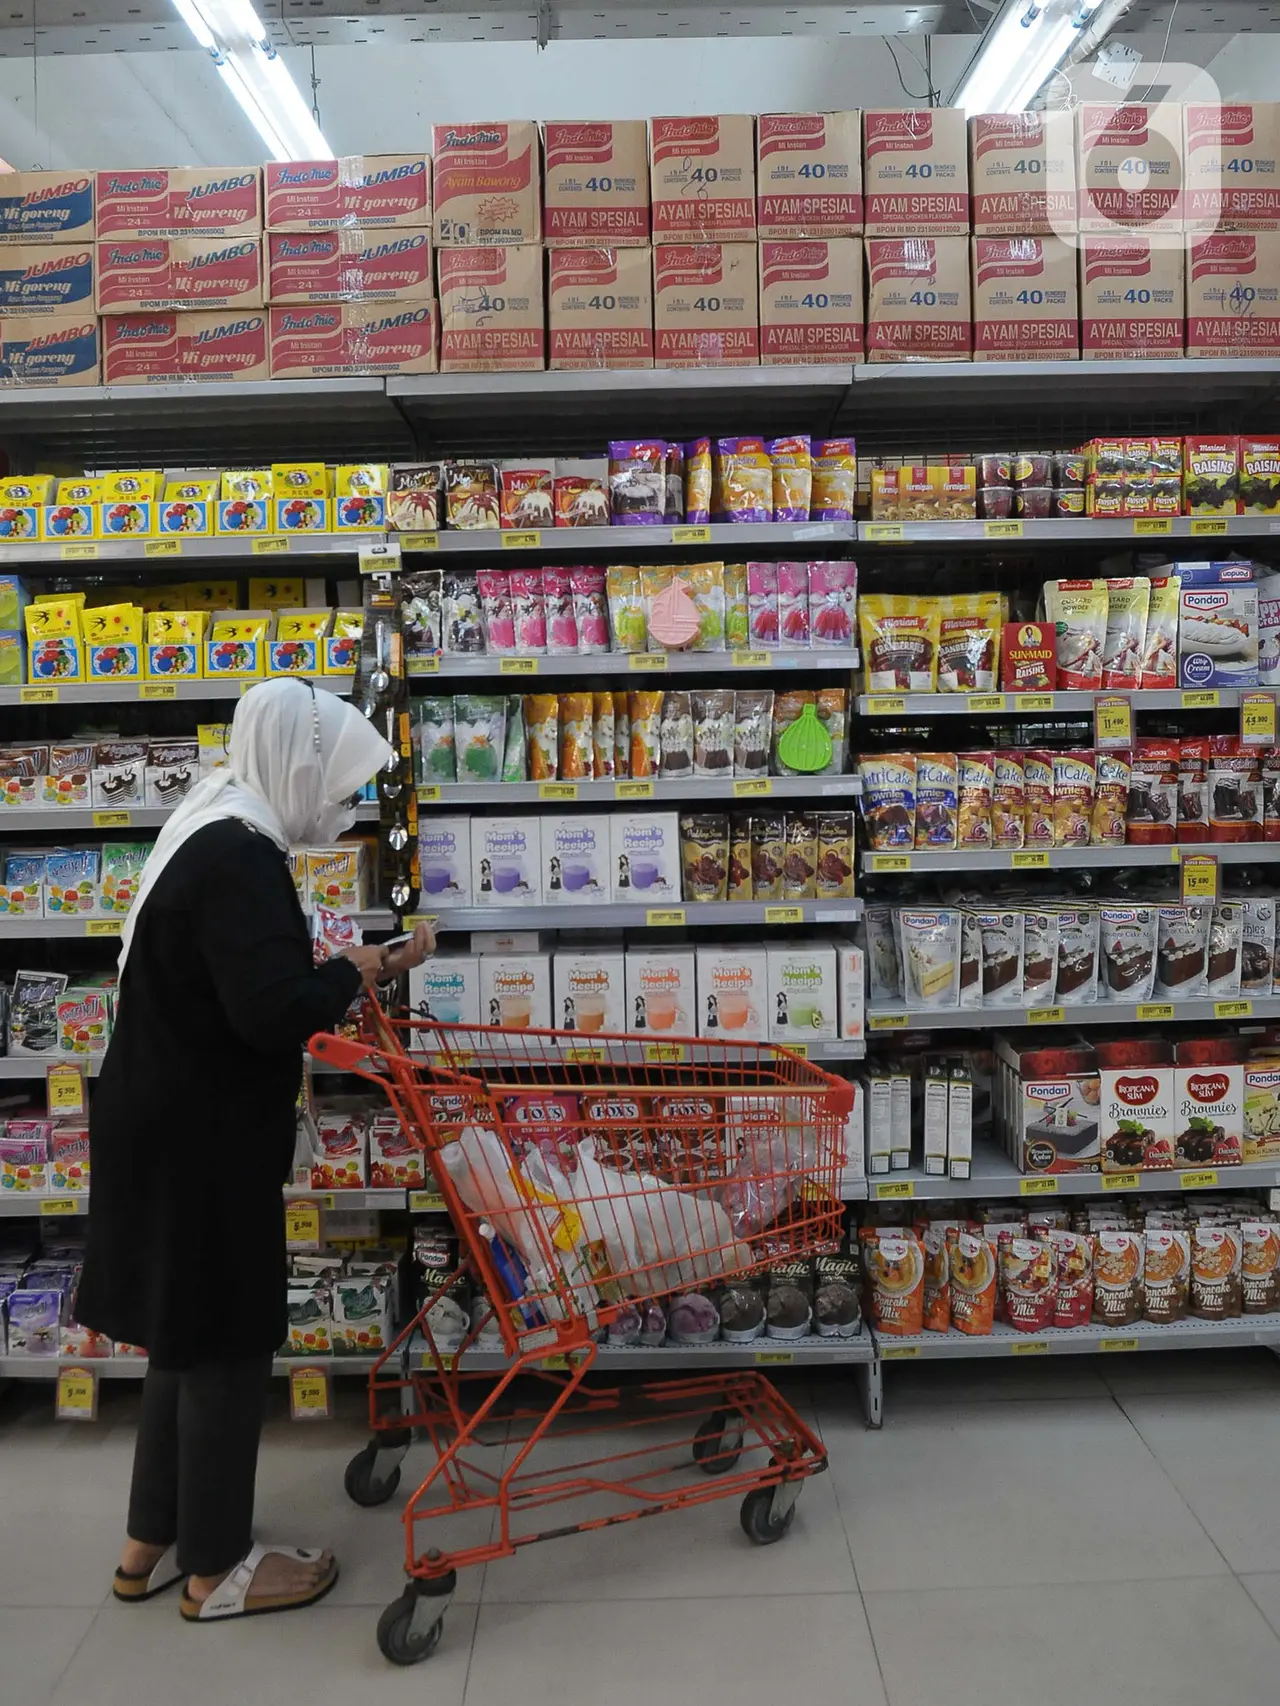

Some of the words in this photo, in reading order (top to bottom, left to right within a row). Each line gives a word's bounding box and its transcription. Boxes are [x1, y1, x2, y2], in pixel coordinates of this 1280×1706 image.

[798, 164, 825, 179] 40
[905, 164, 932, 179] 40
[1014, 159, 1041, 174] 40
[1121, 159, 1147, 175] 40
[1227, 158, 1253, 173] 40
[357, 161, 426, 190] JUMBO
[690, 168, 717, 182] 40
[186, 173, 256, 201] JUMBO
[444, 176, 475, 189] Ayam
[476, 176, 521, 189] Bawang
[585, 177, 612, 192] 40
[21, 178, 90, 207] JUMBO
[363, 196, 419, 211] goreng
[764, 199, 800, 214] AYAM
[803, 197, 856, 213] SPESIAL
[872, 198, 908, 213] AYAM
[911, 196, 964, 212] SPESIAL
[981, 197, 1018, 213] AYAM
[1087, 193, 1123, 209] AYAM
[1126, 193, 1178, 208] SPESIAL
[1192, 192, 1229, 209] AYAM
[21, 208, 71, 221] goreng
[193, 208, 248, 222] goreng
[658, 204, 695, 220] AYAM
[699, 202, 751, 219] SPESIAL
[552, 211, 587, 226] AYAM
[591, 211, 643, 226] SPESIAL
[358, 235, 426, 263] JUMBO
[187, 242, 256, 271] JUMBO
[22, 252, 91, 280] JUMBO
[363, 270, 420, 285] goreng
[22, 282, 72, 295] goreng
[194, 278, 249, 292] goreng
[588, 295, 616, 310] 40
[801, 294, 828, 308] 40
[909, 291, 936, 306] 40
[1016, 290, 1043, 304] 40
[1124, 289, 1151, 304] 40
[693, 297, 720, 312] 40
[360, 308, 429, 336] JUMBO
[1196, 321, 1231, 337] AYAM
[26, 323, 96, 351] JUMBO
[193, 317, 263, 346] JUMBO
[768, 329, 804, 344] AYAM
[807, 327, 860, 343] SPESIAL
[876, 325, 913, 341] AYAM
[915, 325, 966, 341] SPESIAL
[982, 324, 1020, 340] AYAM
[1022, 323, 1075, 339] SPESIAL
[1090, 322, 1126, 338] AYAM
[1129, 322, 1182, 338] SPESIAL
[446, 334, 481, 348] AYAM
[485, 332, 538, 348] SPESIAL
[555, 332, 591, 348] AYAM
[595, 331, 648, 347] SPESIAL
[661, 333, 698, 349] AYAM
[367, 342, 423, 357] goreng
[27, 354, 76, 366] goreng
[200, 352, 256, 367] goreng
[1199, 444, 1227, 452] Mariani
[1191, 460, 1235, 476] RAISINS
[1246, 460, 1280, 476] RAISIN
[905, 483, 934, 492] fermipan
[943, 483, 971, 492] fermipan
[1187, 595, 1226, 606] Pondan
[1063, 604, 1090, 612] POWDER
[884, 617, 919, 629] Mariani
[943, 618, 978, 629] Mariani
[1015, 666, 1046, 679] RAISINS
[1187, 664, 1212, 674] Cream
[863, 766, 913, 786] utriCake
[868, 789, 905, 802] rownies
[486, 830, 525, 842] Mom's
[556, 828, 595, 840] Mom's
[624, 827, 663, 838] Mom's
[486, 842, 526, 854] Recipe
[555, 840, 595, 852] Recipe
[624, 838, 664, 850] Recipe
[905, 917, 935, 926] Pondan
[1103, 911, 1133, 920] Pondan
[494, 971, 534, 982] Mom's
[568, 969, 608, 981] Mom's
[640, 967, 679, 979] Mom's
[712, 966, 752, 978] Mom's
[781, 964, 822, 975] Mom's
[424, 972, 464, 984] Mom's
[640, 979, 680, 990] Recipe
[712, 978, 753, 990] Recipe
[782, 975, 822, 987] Recipe
[424, 984, 465, 996] Recipe
[494, 982, 535, 994] Recipe
[568, 981, 609, 993] Recipe
[1030, 1086, 1068, 1096] Pondan
[1118, 1084, 1156, 1095] TROPICANA
[1190, 1082, 1227, 1092] TROPICANA
[1198, 1089, 1214, 1098] SLIM
[1127, 1091, 1144, 1101] SLIM
[1108, 1102, 1169, 1120] Brownies
[1181, 1100, 1239, 1117] Brownies
[420, 1253, 446, 1262] Pondan
[815, 1256, 860, 1277] Magic
[420, 1268, 466, 1285] Mac
[1096, 1287, 1135, 1301] Pancake
[1192, 1281, 1232, 1294] Pancake
[1244, 1288, 1267, 1300] Mix
[873, 1292, 909, 1307] Pancake
[1007, 1291, 1045, 1306] Pancake
[1103, 1299, 1127, 1312] Mix
[1146, 1296, 1170, 1309] Mix
[1200, 1293, 1223, 1306] Mix
[879, 1306, 901, 1319] Mix
[1012, 1303, 1036, 1316] Mix
